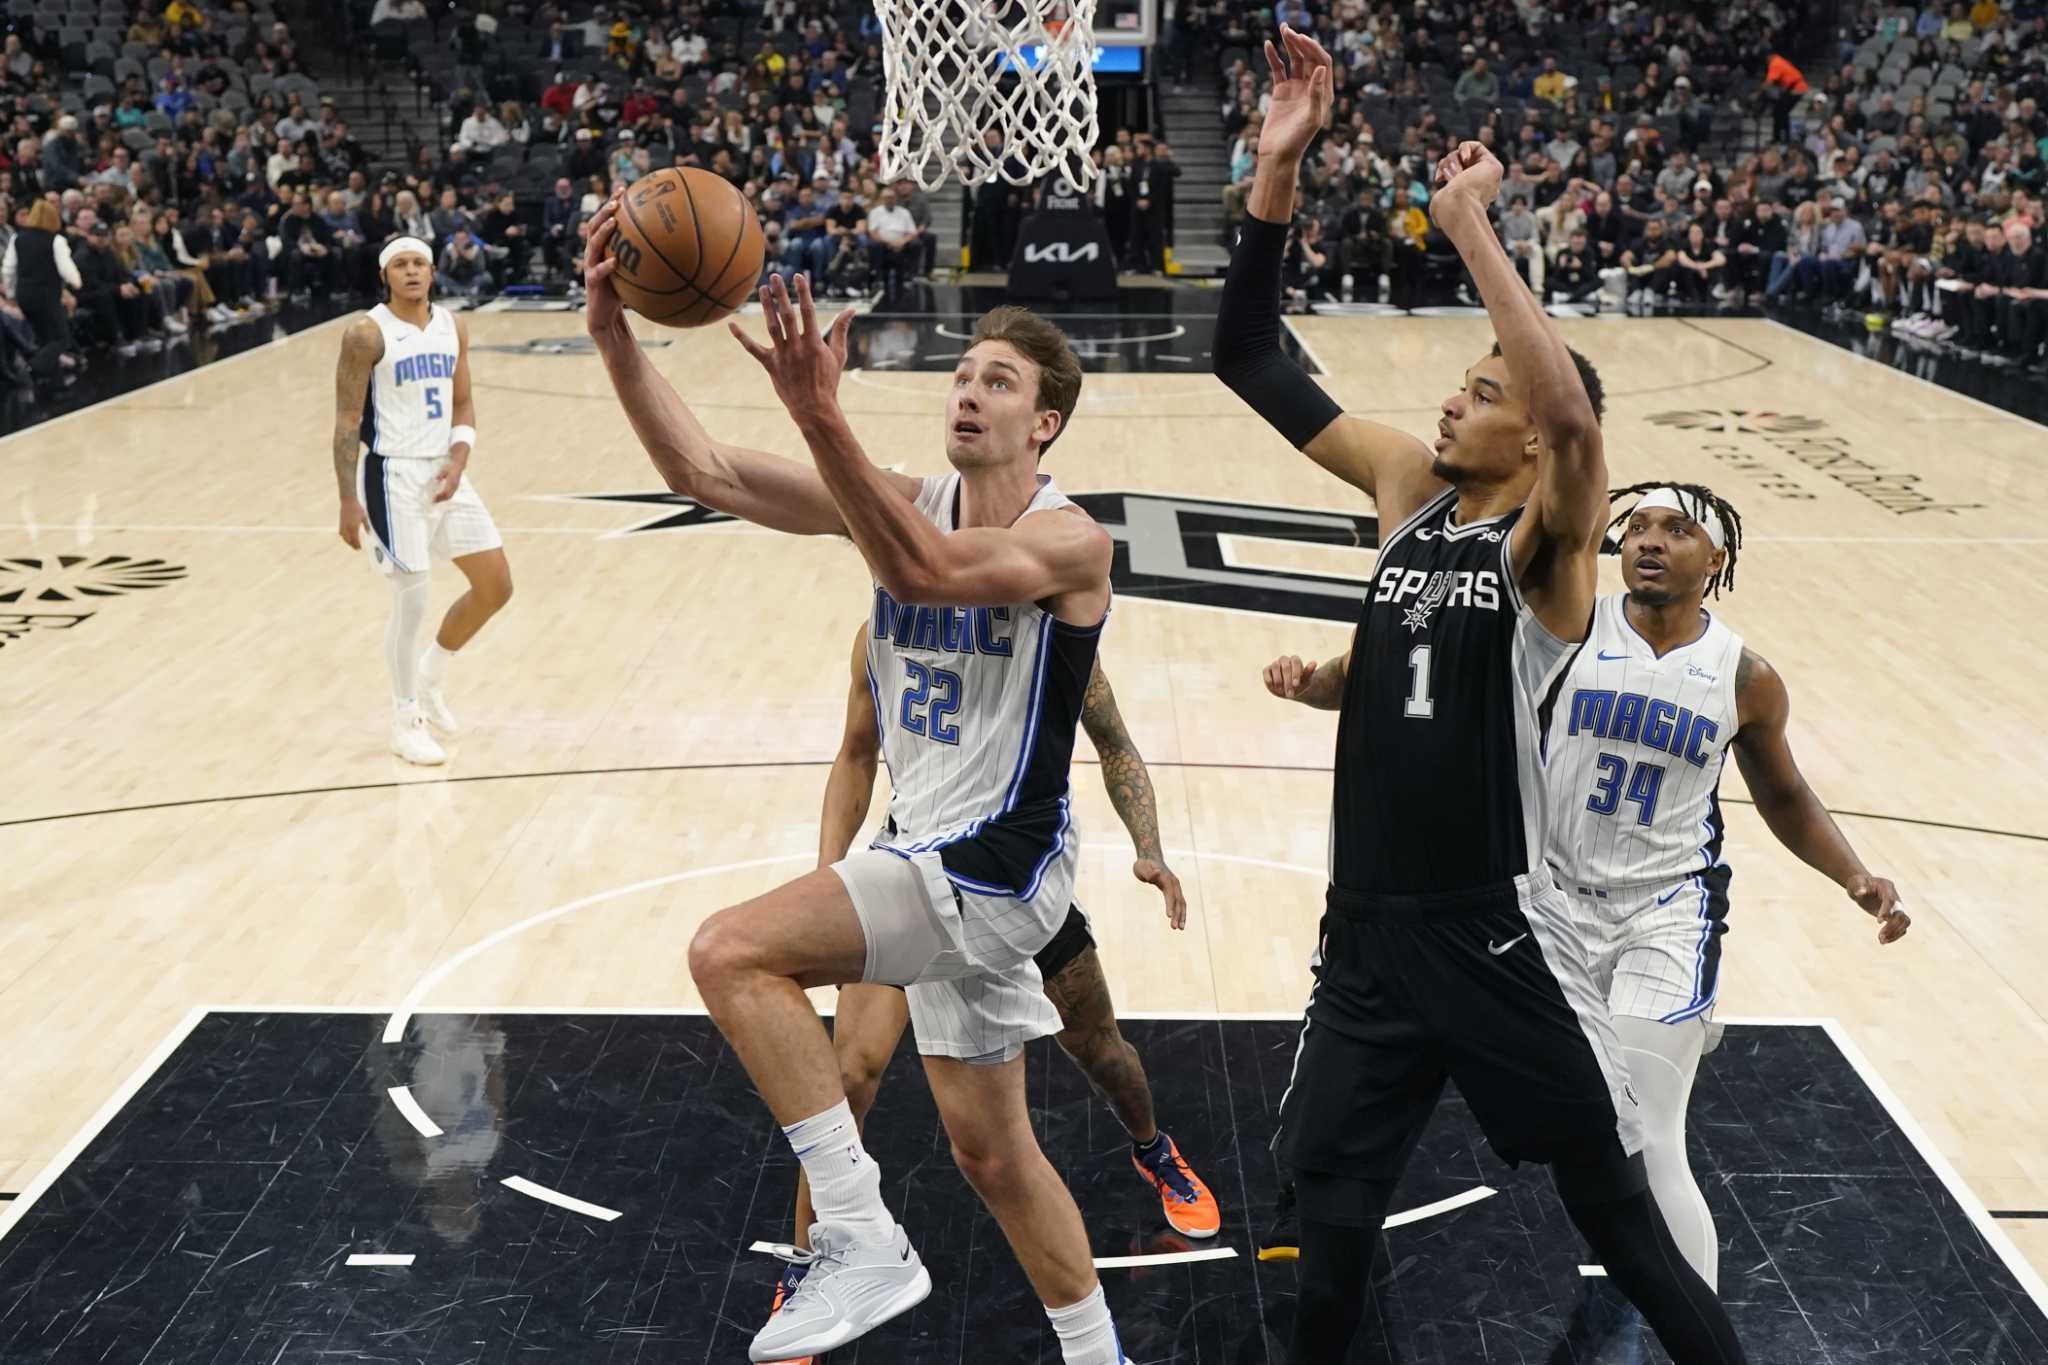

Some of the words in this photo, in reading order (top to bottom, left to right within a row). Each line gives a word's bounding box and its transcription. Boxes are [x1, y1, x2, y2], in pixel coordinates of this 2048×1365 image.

[1024, 242, 1099, 263] KIA
[425, 387, 443, 419] 5
[1374, 567, 1500, 612] SPURS
[900, 657, 963, 746] 22
[1404, 645, 1434, 719] 1
[1568, 689, 1720, 769] MAGIC
[1586, 752, 1665, 826] 34
